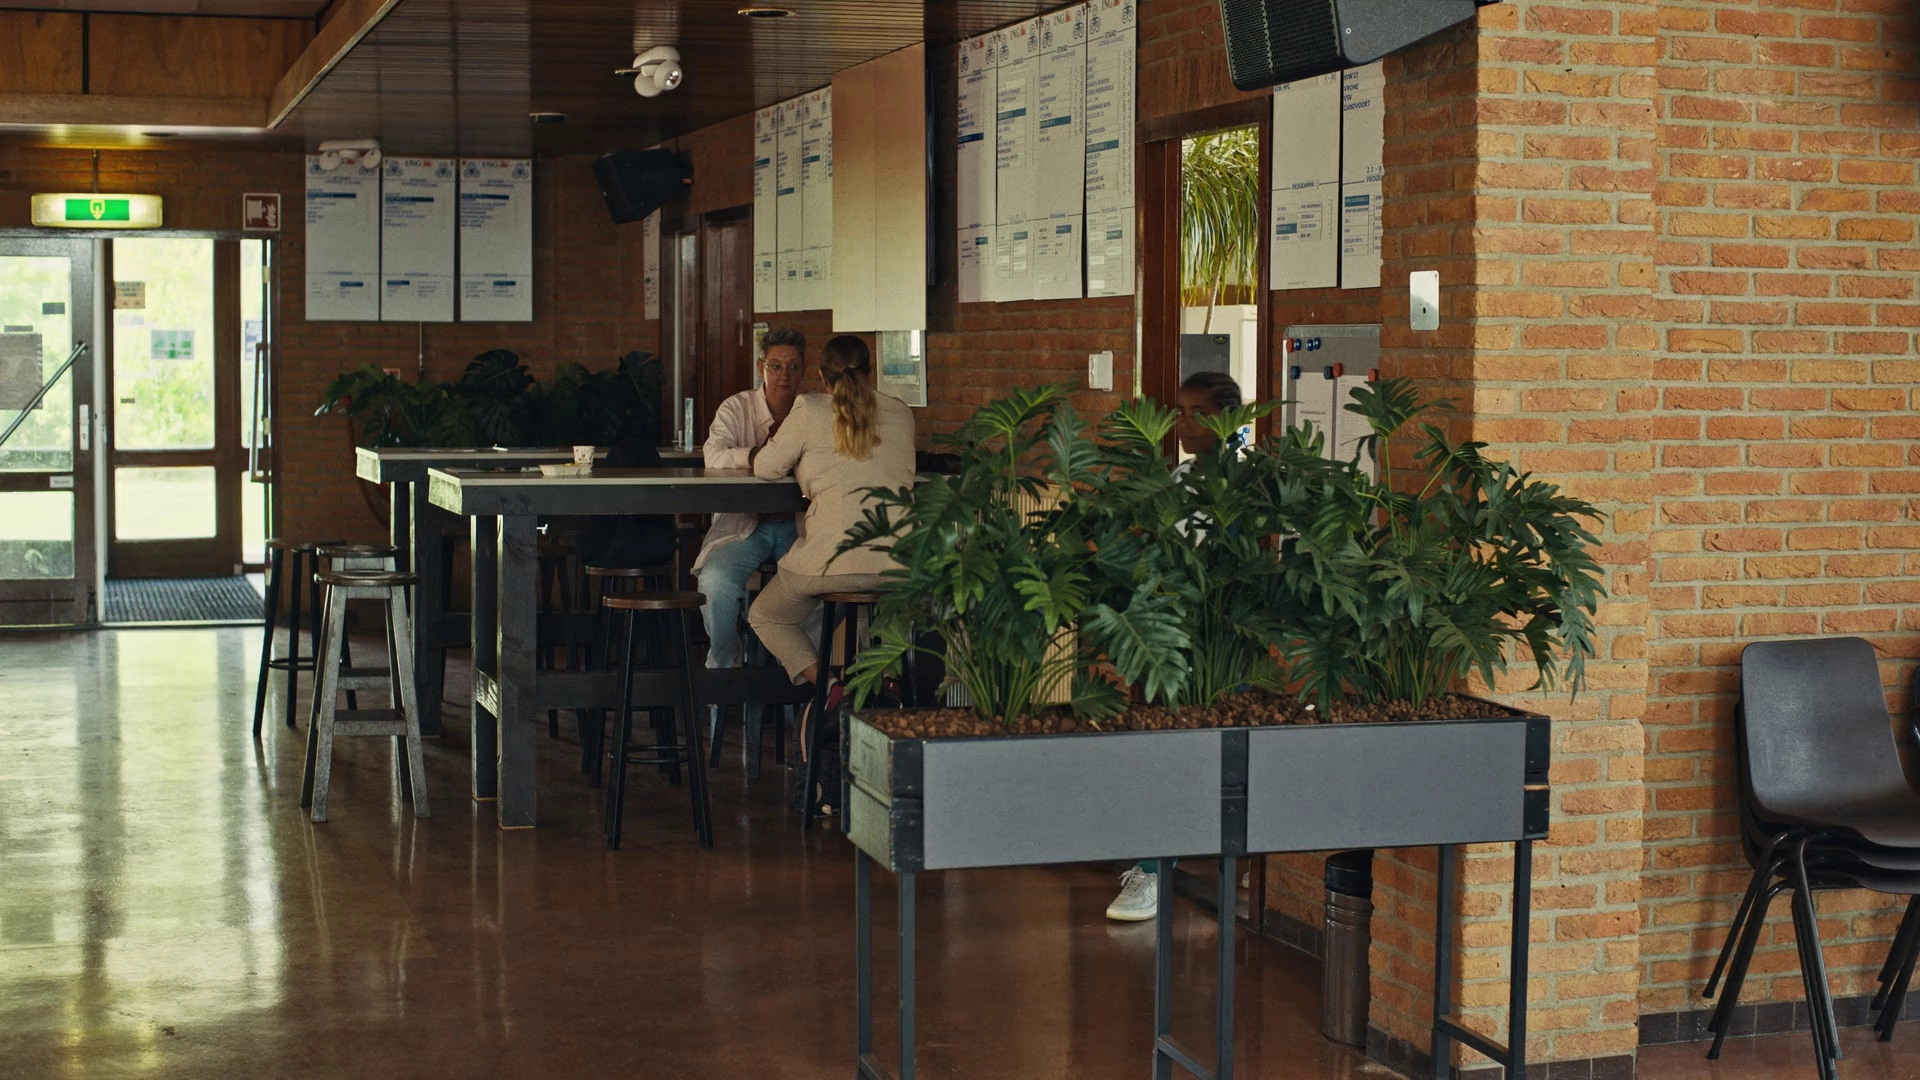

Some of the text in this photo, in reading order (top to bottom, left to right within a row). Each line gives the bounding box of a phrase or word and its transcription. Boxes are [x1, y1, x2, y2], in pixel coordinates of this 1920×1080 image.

[1054, 14, 1065, 26] ING
[1009, 28, 1020, 40] ING
[1343, 83, 1359, 92] VRONE
[1343, 100, 1371, 111] ZANDVOORT
